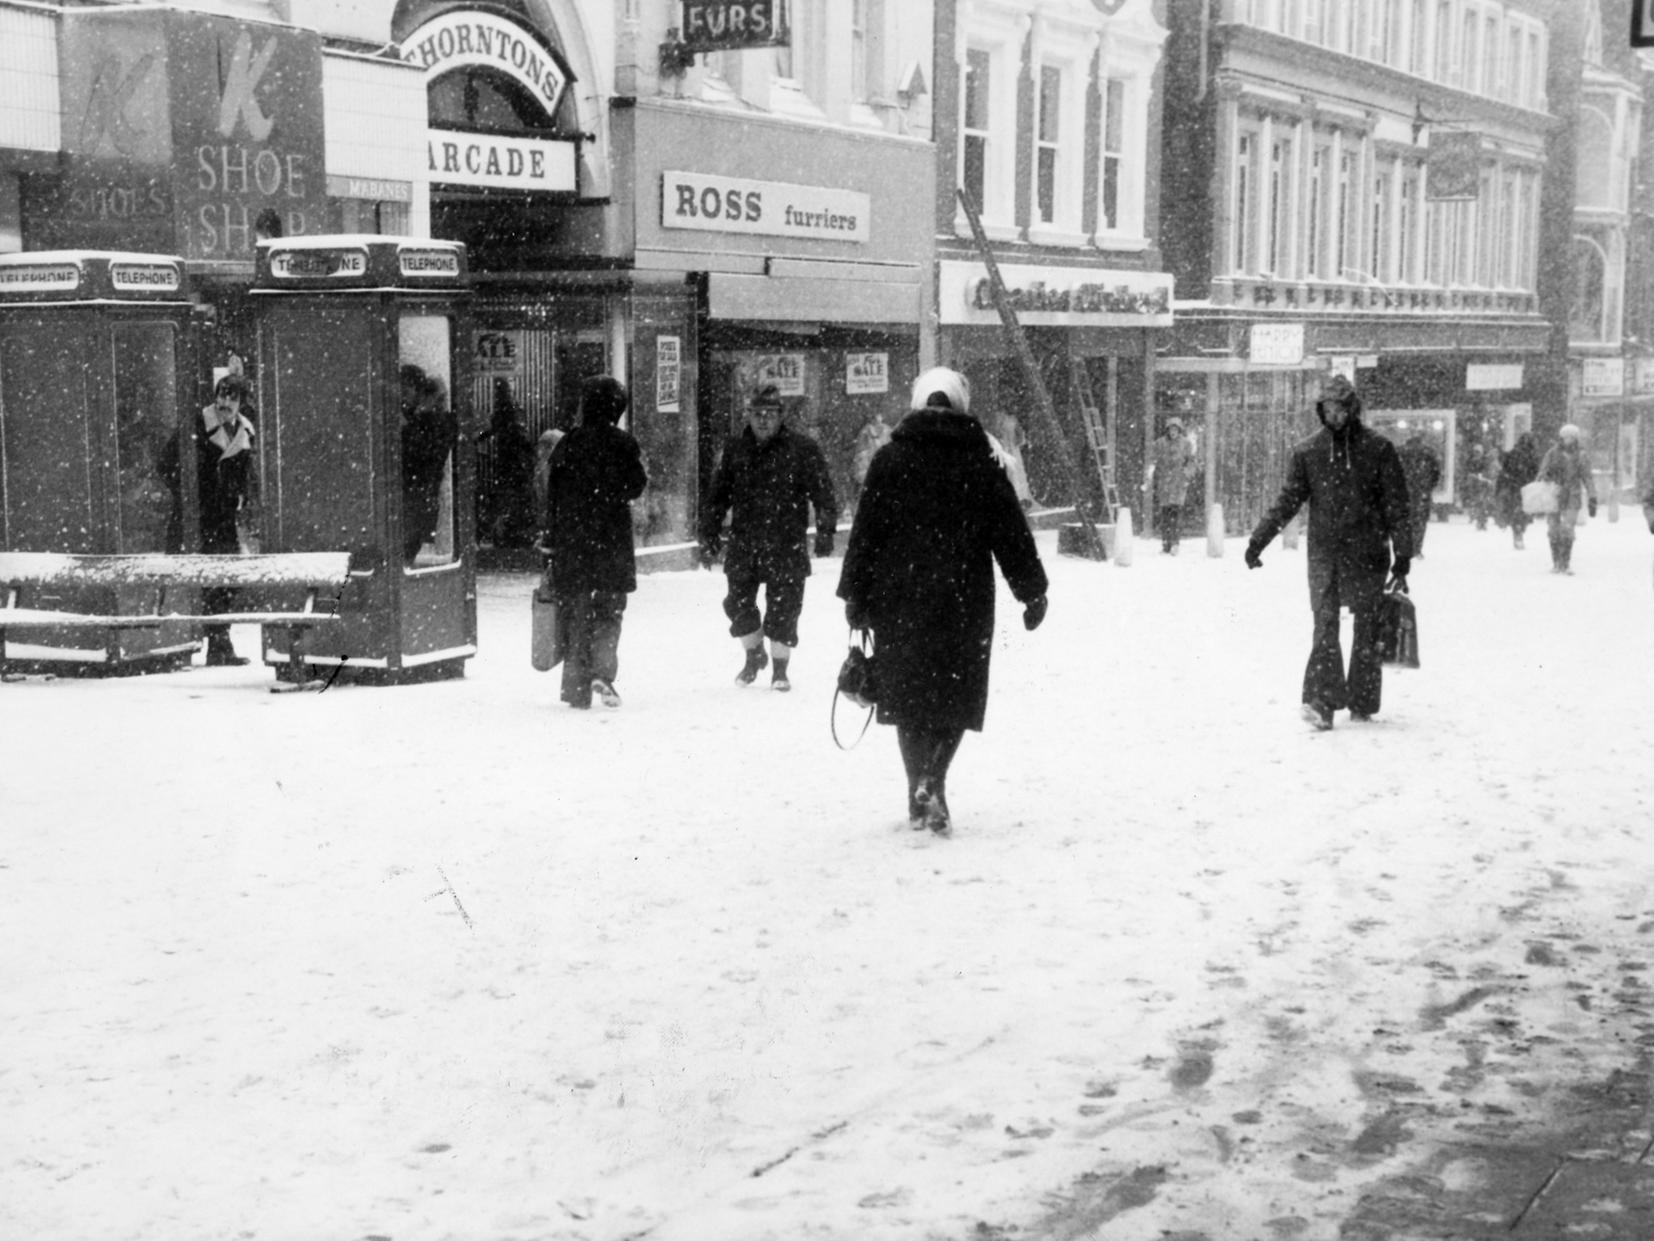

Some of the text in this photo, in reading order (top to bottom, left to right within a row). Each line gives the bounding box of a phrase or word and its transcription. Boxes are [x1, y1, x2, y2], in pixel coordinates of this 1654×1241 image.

[688, 3, 766, 35] FURS
[217, 31, 277, 141] K
[199, 145, 305, 198] SHOE
[200, 203, 305, 251] SHP
[675, 184, 857, 231] ROSS furriers
[115, 271, 174, 285] TELEPHONE
[403, 257, 455, 271] TELEPHONE
